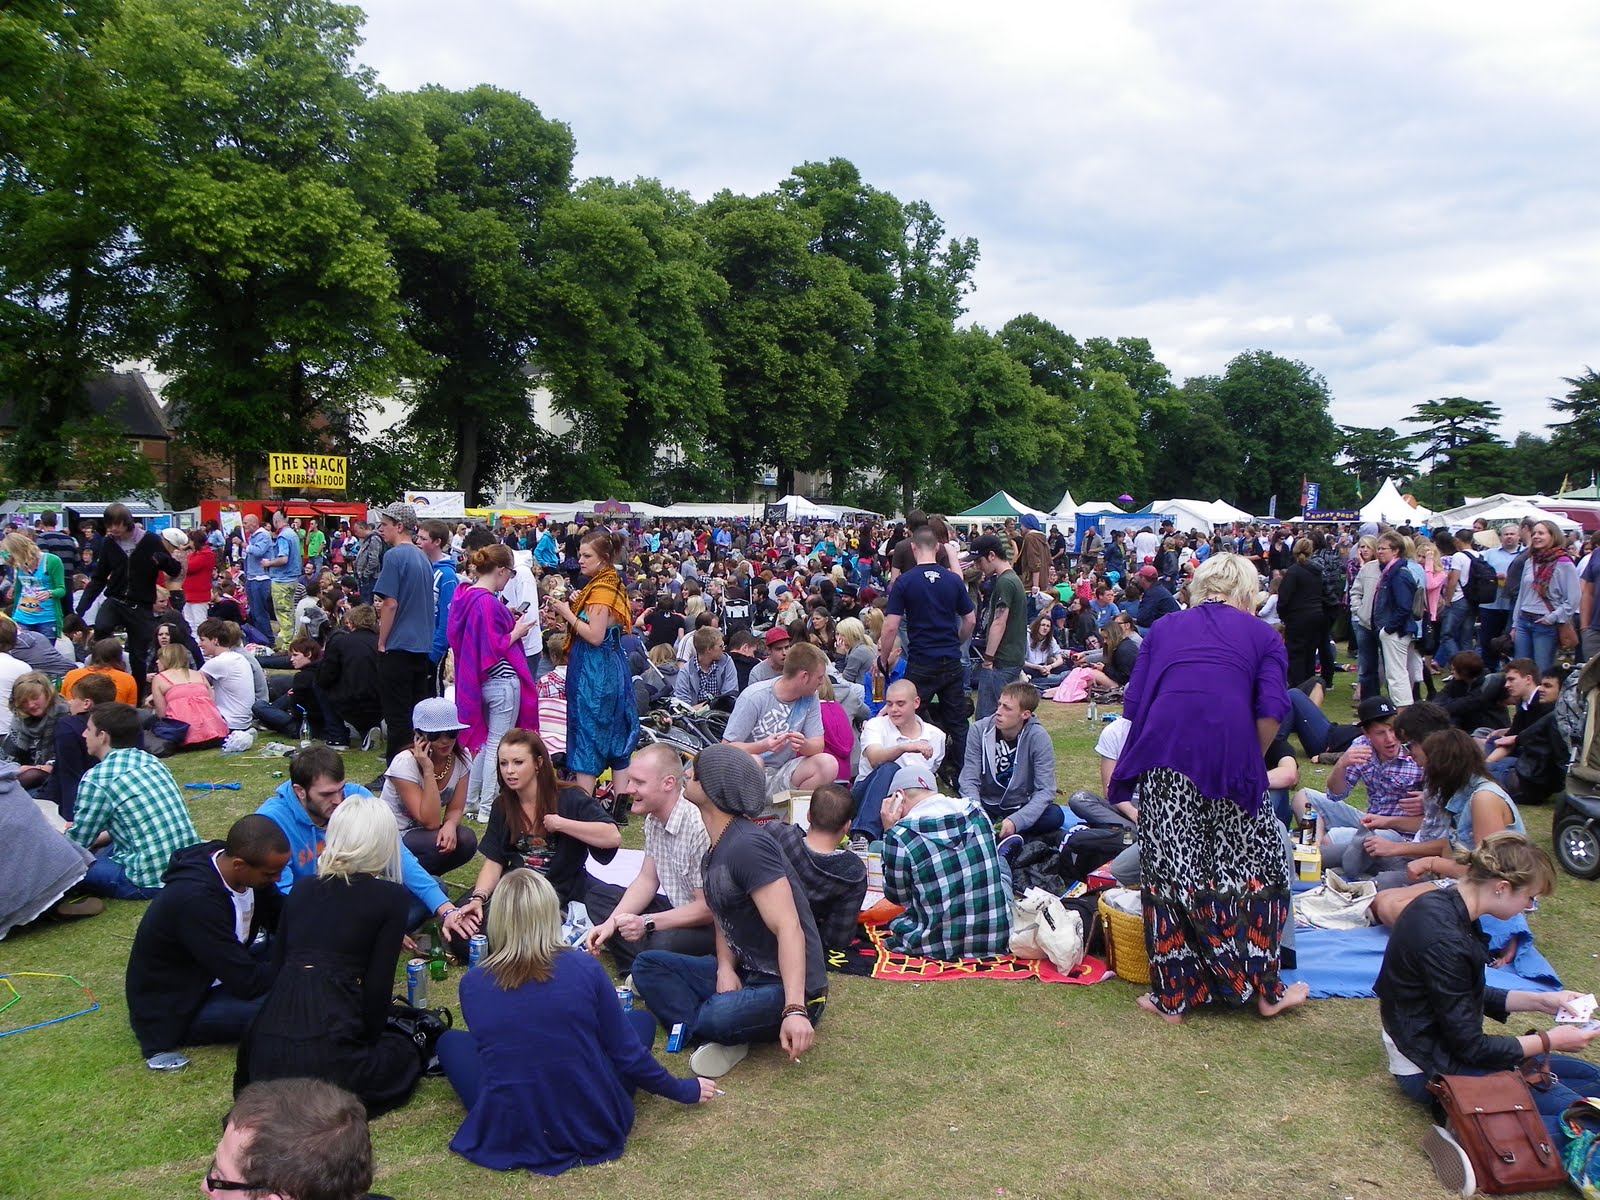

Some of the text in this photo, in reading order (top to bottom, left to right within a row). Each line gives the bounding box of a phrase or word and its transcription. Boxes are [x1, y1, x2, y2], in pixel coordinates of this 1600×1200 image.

[273, 456, 344, 474] THE SHACK
[274, 473, 344, 486] CARIBBEAN FOOD
